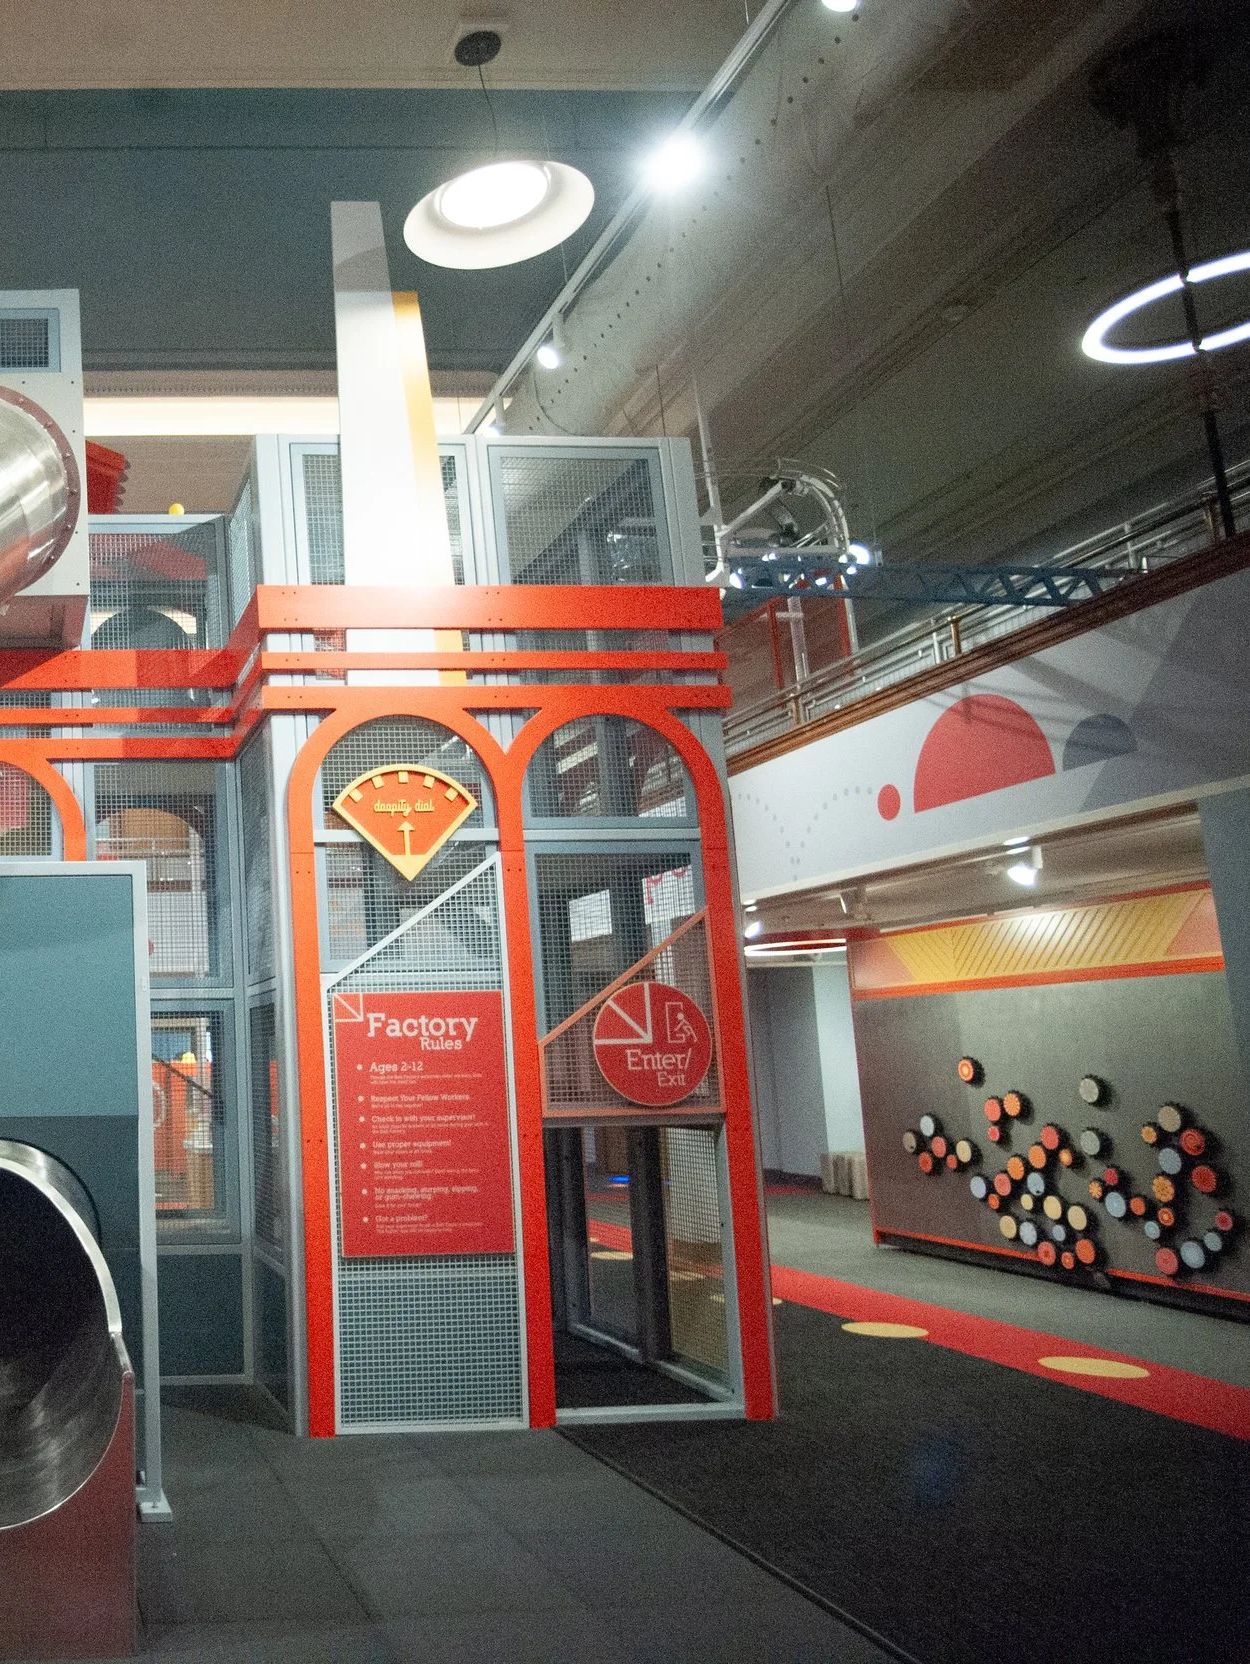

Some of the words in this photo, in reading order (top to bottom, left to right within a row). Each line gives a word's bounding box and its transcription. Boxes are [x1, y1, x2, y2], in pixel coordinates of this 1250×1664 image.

[414, 799, 435, 812] dial
[366, 1013, 478, 1041] Factory
[419, 1036, 463, 1051] Rules
[625, 1047, 692, 1071] Enter/
[370, 1062, 398, 1074] Ages
[401, 1061, 424, 1072] 2-12
[657, 1071, 686, 1087] Exit
[371, 1095, 399, 1103] Respect
[400, 1094, 416, 1102] Your
[440, 1093, 470, 1101] Workers
[371, 1115, 394, 1123] Check
[403, 1114, 419, 1122] with
[420, 1115, 435, 1123] your
[387, 1141, 411, 1149] proper
